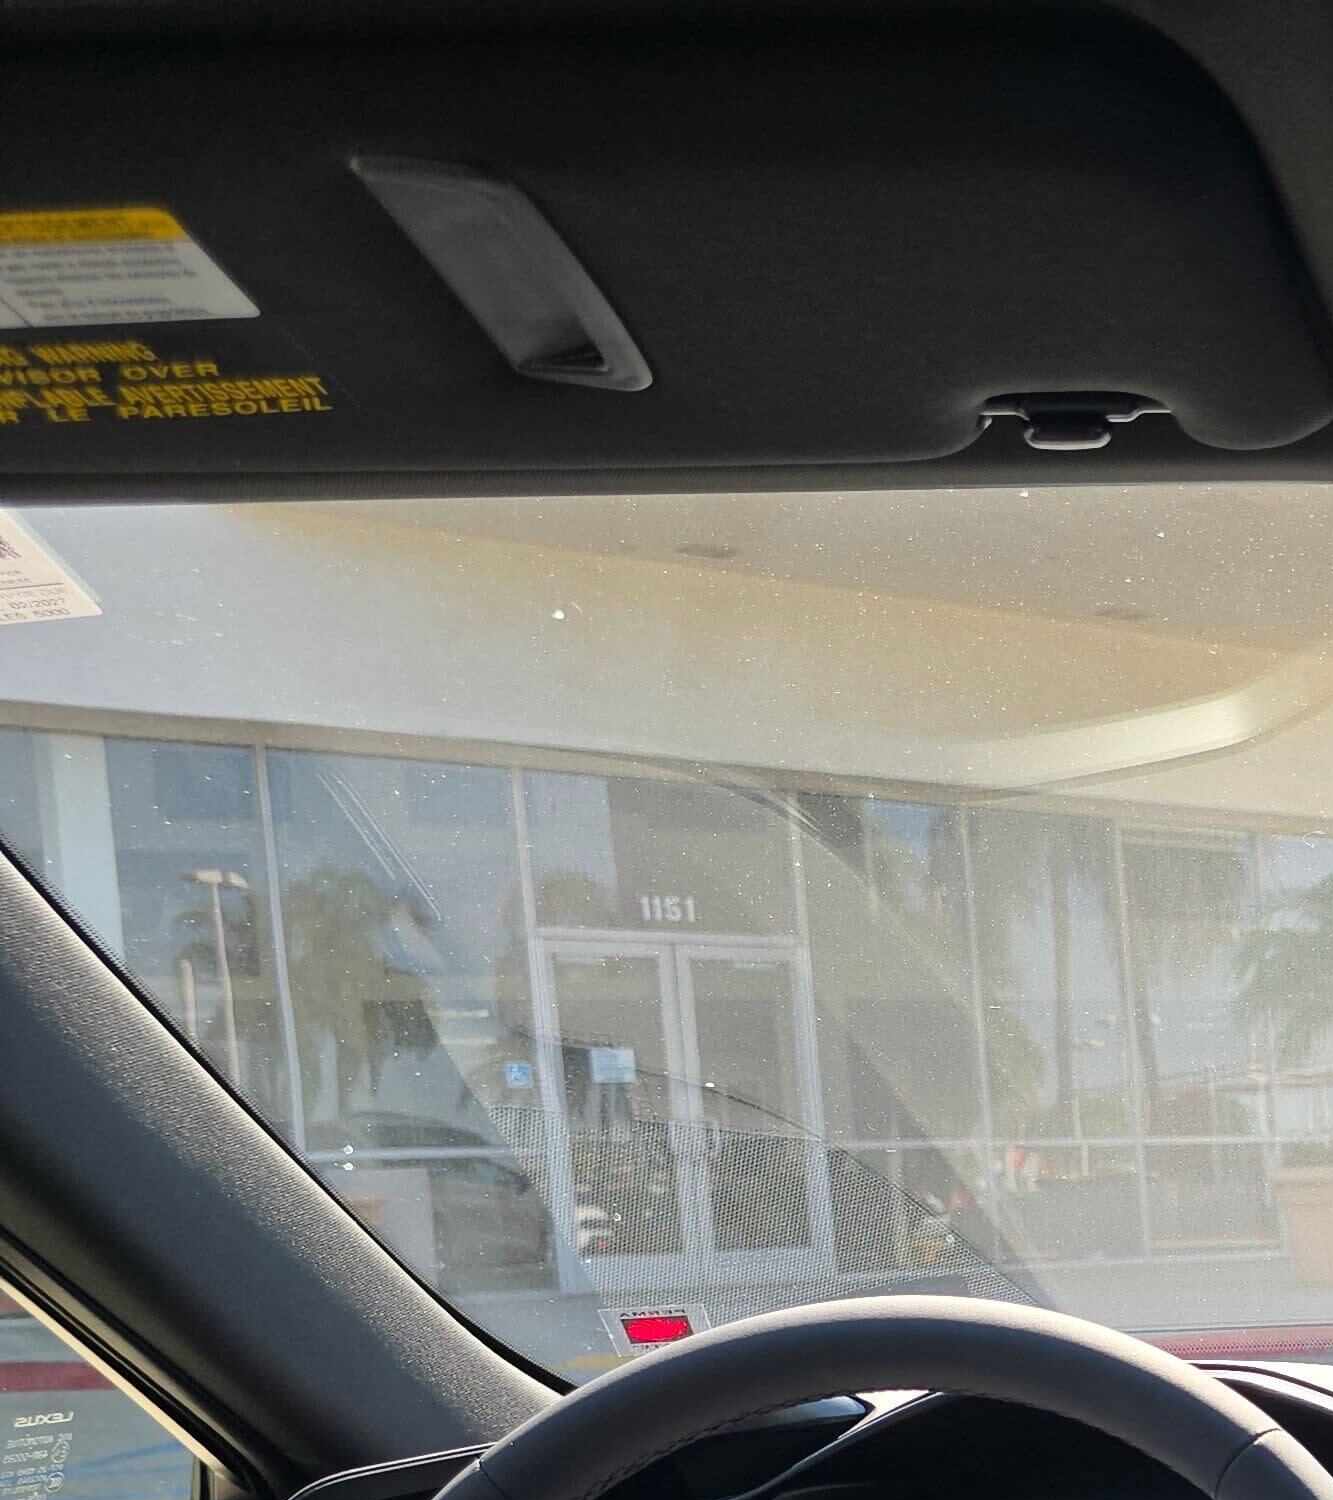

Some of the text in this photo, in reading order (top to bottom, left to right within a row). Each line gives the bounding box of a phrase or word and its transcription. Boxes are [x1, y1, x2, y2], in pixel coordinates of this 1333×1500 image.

[122, 362, 219, 381] OVER
[119, 378, 328, 405] AVERTISSEMENT
[119, 397, 332, 419] PARESOLEIL
[640, 896, 696, 922] 1151
